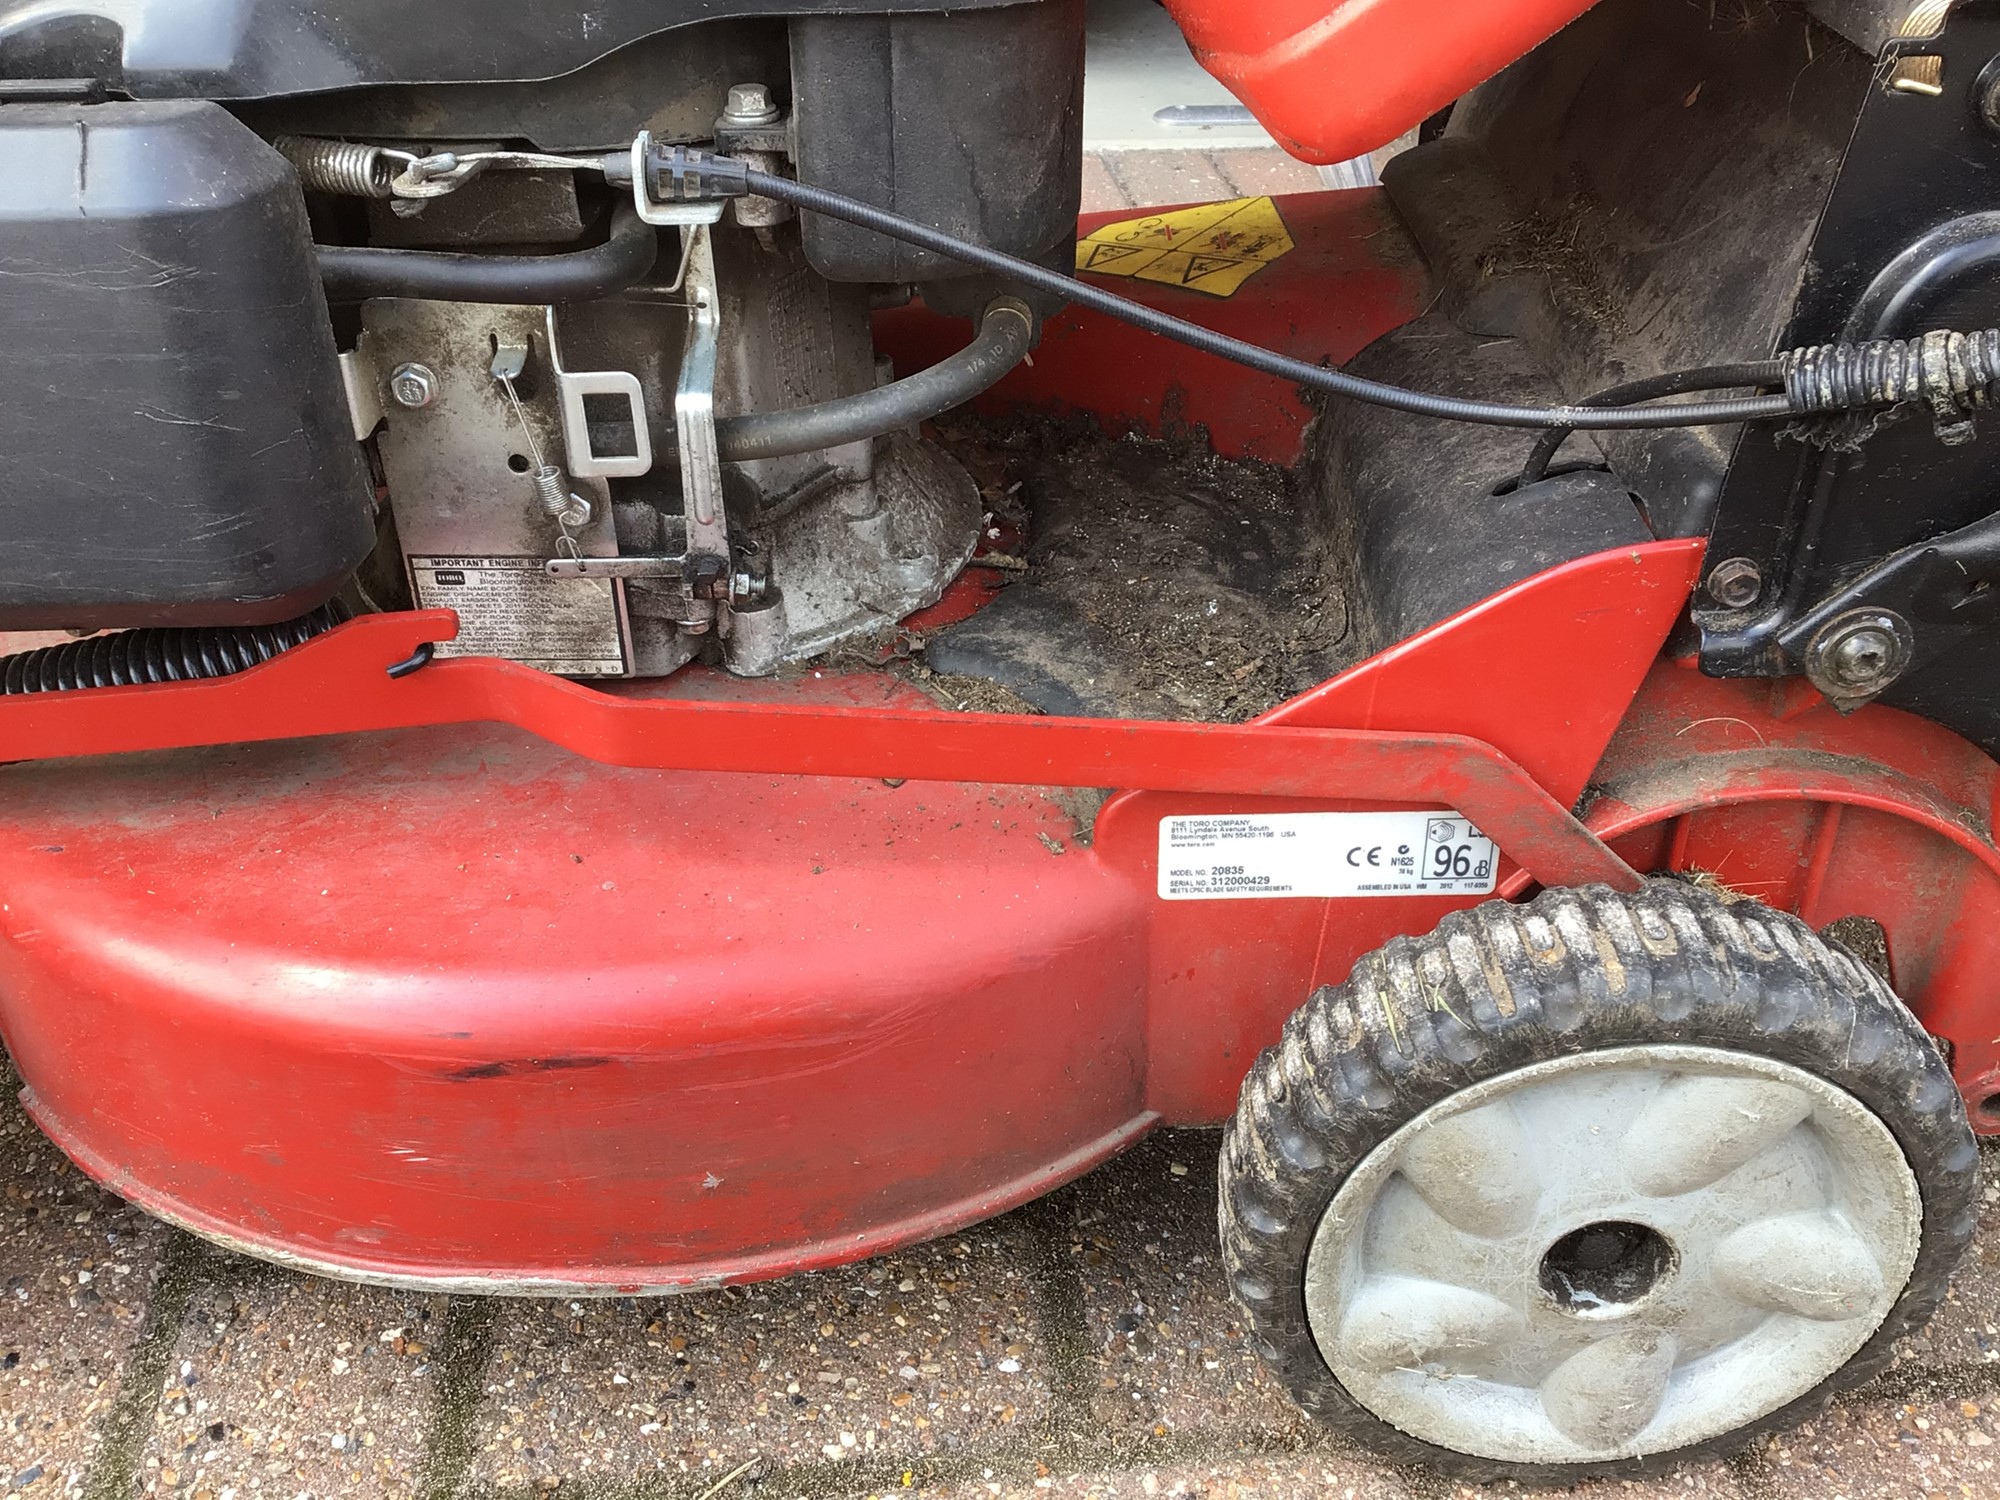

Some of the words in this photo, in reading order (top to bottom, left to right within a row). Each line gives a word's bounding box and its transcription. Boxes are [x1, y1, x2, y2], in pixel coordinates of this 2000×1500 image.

[431, 559, 484, 567] IMPORTANT
[490, 559, 524, 567] ENGINE
[1190, 827, 1217, 835] Lyndale
[1391, 857, 1414, 866] N1625
[1433, 844, 1472, 877] 96
[1211, 866, 1244, 876] 20835
[1211, 876, 1270, 886] 312000429
